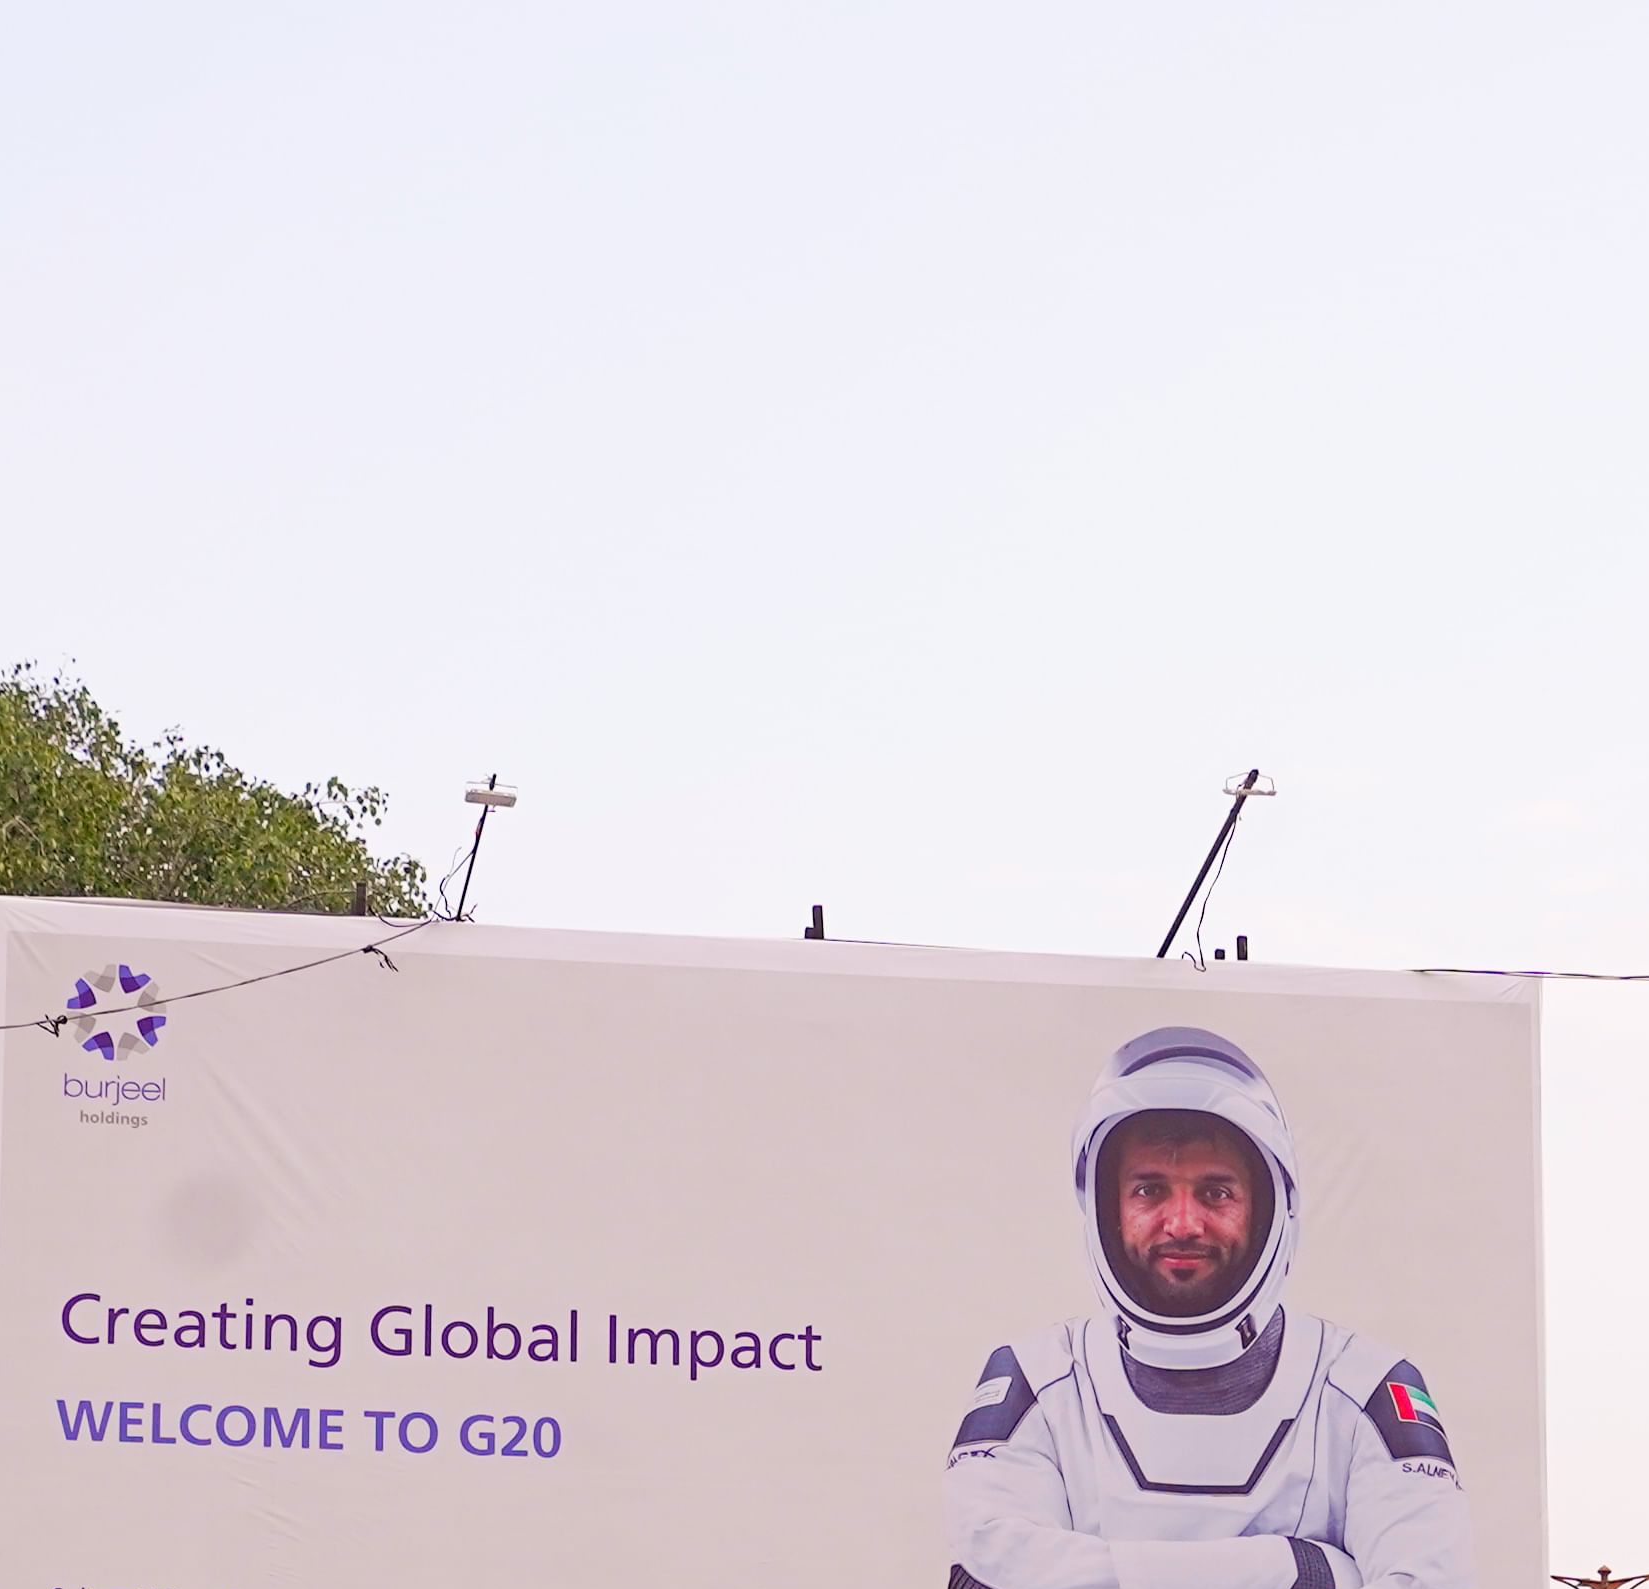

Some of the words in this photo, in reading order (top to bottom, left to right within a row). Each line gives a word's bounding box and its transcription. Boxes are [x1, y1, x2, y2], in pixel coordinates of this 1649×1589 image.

[63, 1072, 166, 1107] burjeel
[79, 1109, 148, 1129] holdings
[61, 1292, 343, 1369] Creating
[369, 1303, 578, 1363] Global
[608, 1314, 824, 1382] Impact
[56, 1399, 344, 1452] WELCOME
[363, 1410, 440, 1454] TO
[459, 1414, 562, 1459] G20
